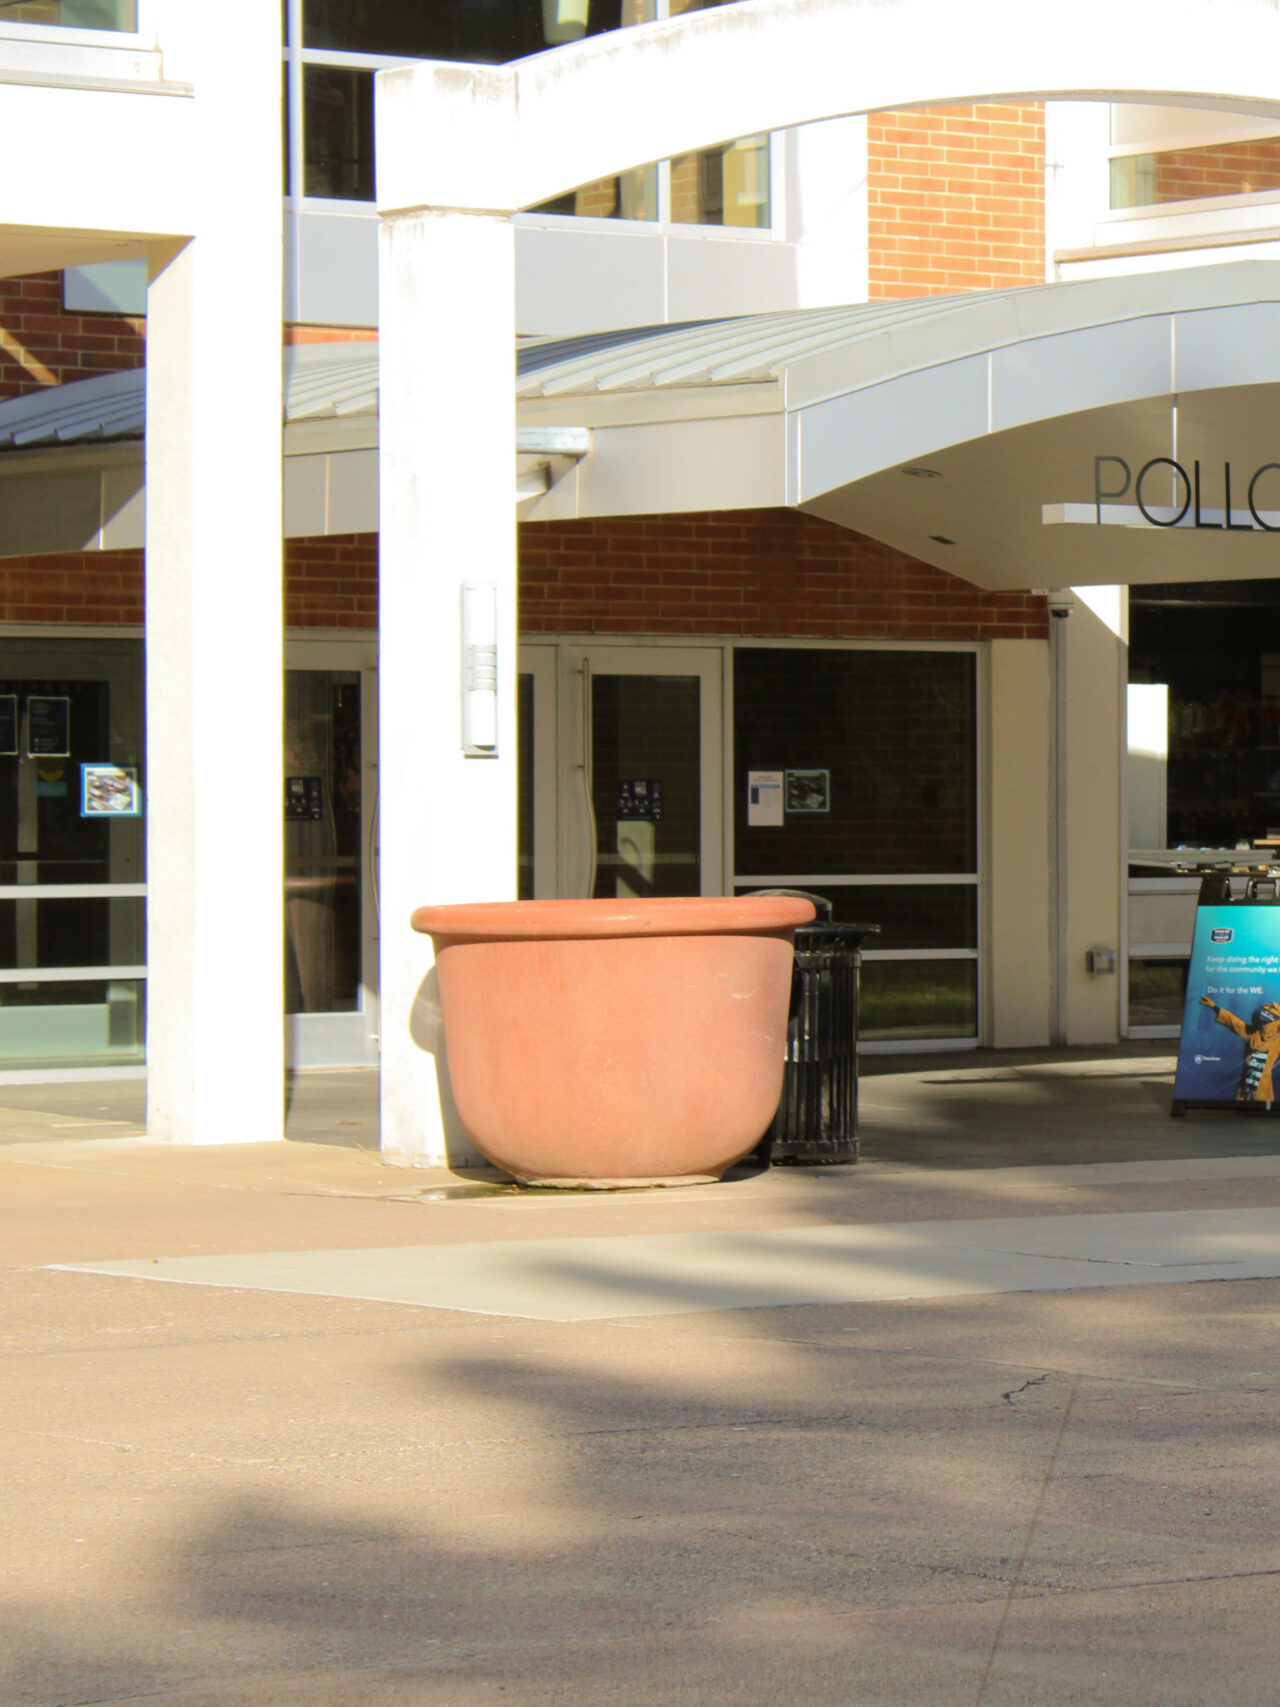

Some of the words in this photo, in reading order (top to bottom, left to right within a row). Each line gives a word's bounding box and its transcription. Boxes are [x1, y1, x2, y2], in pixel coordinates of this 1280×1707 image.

[1227, 956, 1247, 965] doing
[1261, 956, 1279, 965] right
[1229, 966, 1266, 975] community
[1207, 986, 1218, 994] Do
[1219, 986, 1225, 994] it
[1226, 986, 1236, 994] for
[1237, 986, 1249, 994] the
